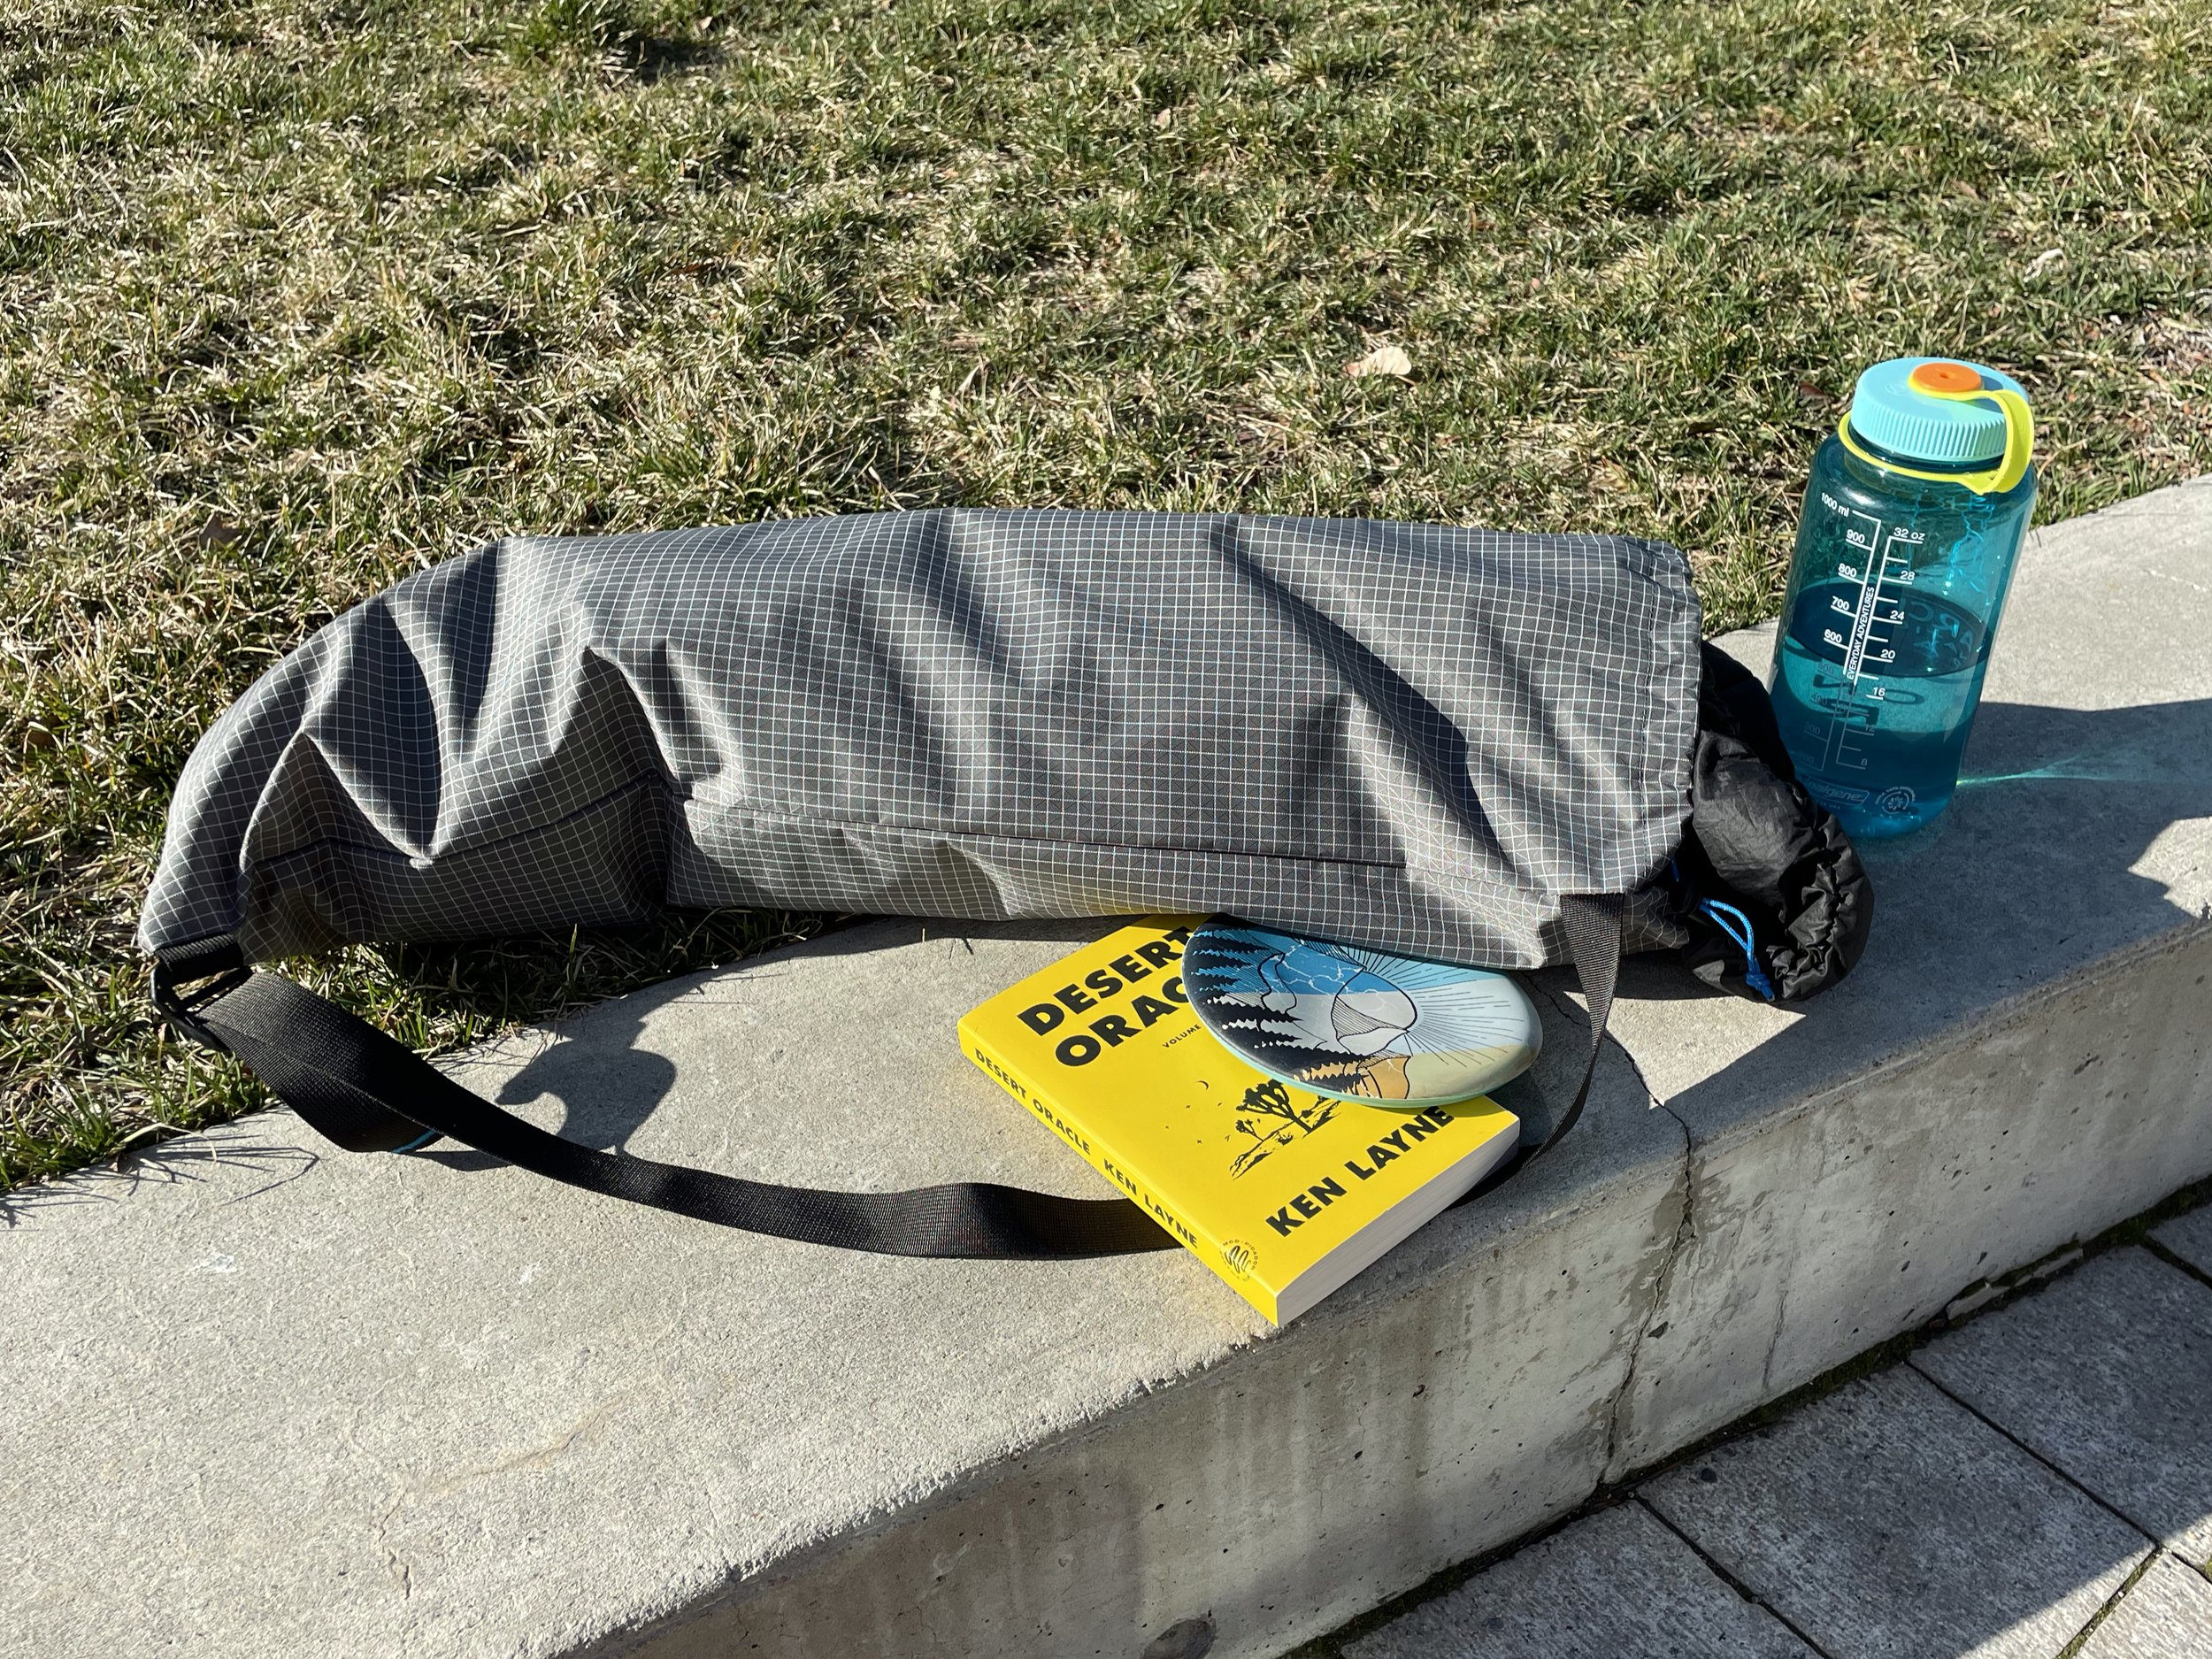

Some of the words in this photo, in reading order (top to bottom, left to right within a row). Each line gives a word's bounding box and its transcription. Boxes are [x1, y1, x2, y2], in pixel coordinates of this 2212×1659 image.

[1822, 492, 1838, 511] 1000
[1838, 504, 1850, 517] ml
[1847, 529, 1865, 544] 900
[1893, 527, 1909, 539] 32
[1911, 532, 1925, 541] oz
[1839, 563, 1856, 578] 800
[1900, 570, 1915, 580] 28
[1832, 595, 1850, 611] 700
[1890, 610, 1905, 620] 24
[1824, 629, 1842, 643] 600
[1847, 640, 1862, 680] EVERYDAY
[1856, 586, 1875, 640] ADVENTURES
[1880, 649, 1896, 659] 20
[1873, 687, 1886, 696] 16
[1861, 757, 1869, 767] 8
[1808, 780, 1864, 803] nalgene
[1016, 926, 1193, 1036] DESERT
[1055, 976, 1190, 1067] ORAC
[1162, 1024, 1202, 1048] VOLUME
[975, 1048, 1026, 1099] DESERT
[1033, 1098, 1091, 1156] ORACLE
[1103, 1158, 1138, 1196] KEN
[1144, 1194, 1199, 1249] LAYNE
[1265, 1176, 1348, 1237] KEN
[1343, 1106, 1455, 1181] LAYNE
